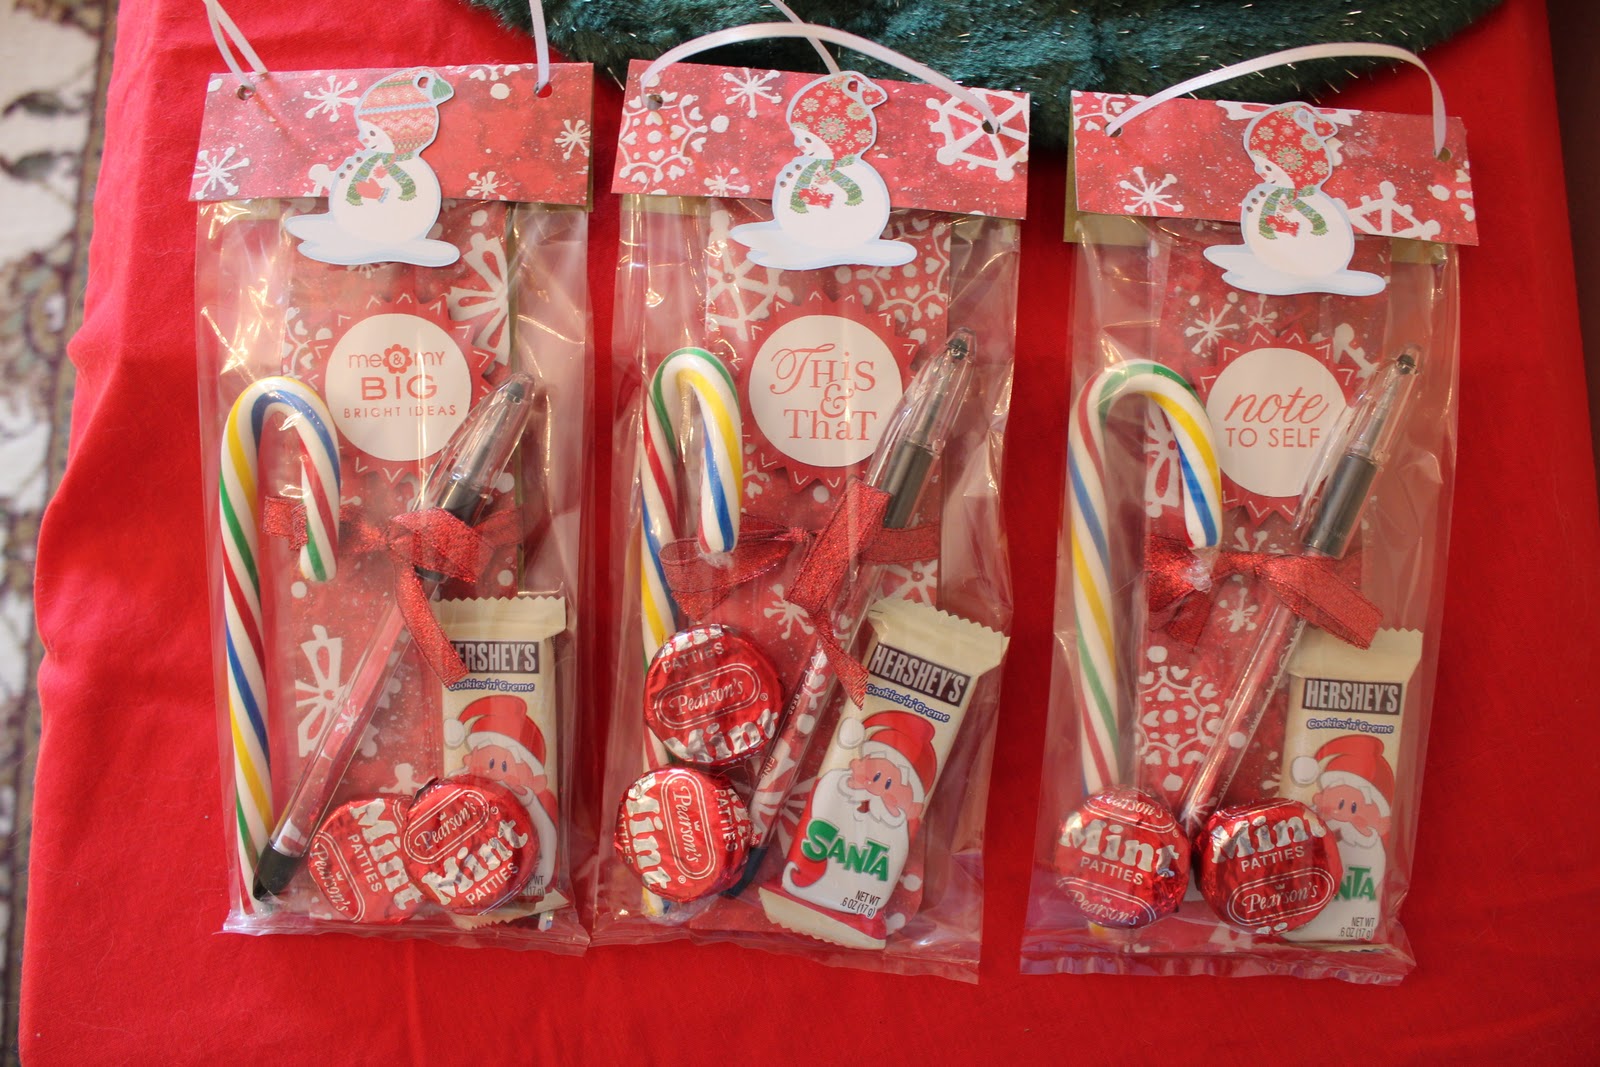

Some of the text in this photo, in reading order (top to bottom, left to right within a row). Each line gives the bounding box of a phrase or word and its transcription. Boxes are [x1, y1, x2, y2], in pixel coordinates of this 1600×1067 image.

[348, 353, 383, 369] me
[361, 374, 438, 401] BIG
[820, 383, 855, 418] &
[1223, 386, 1330, 424] note
[343, 404, 457, 419] BRIGHT IDEAS
[1225, 427, 1321, 448] TO SELF
[451, 643, 537, 672] ERSHEY'S
[661, 641, 725, 674] PATTIES
[868, 644, 967, 704] HERSHEY'S
[668, 678, 744, 716] Pearson's
[1304, 679, 1399, 714] HERSHEY'S
[413, 801, 477, 852] Pearson's
[625, 773, 672, 889] Mint
[671, 785, 702, 863] Pearson's
[714, 788, 739, 853] PATTIES
[348, 833, 383, 892] PATTIES
[349, 797, 424, 911] Mint
[421, 819, 529, 906] Mint
[801, 819, 889, 882] SANTA
[1059, 811, 1180, 878] Mint
[1240, 845, 1306, 873] PATTIES
[310, 842, 351, 912] Pearson's
[465, 862, 519, 905] PATTIES
[1080, 856, 1144, 885] PATTIES
[1334, 866, 1377, 902] NTA
[847, 899, 858, 911] OZ
[856, 901, 868, 914] (17
[855, 890, 881, 907] NET WT
[1066, 889, 1140, 926] Pearson's
[1241, 881, 1319, 914] Pearson's
[1345, 927, 1355, 938] OZ
[1355, 927, 1366, 938] (17
[1351, 917, 1376, 927] NET WT
